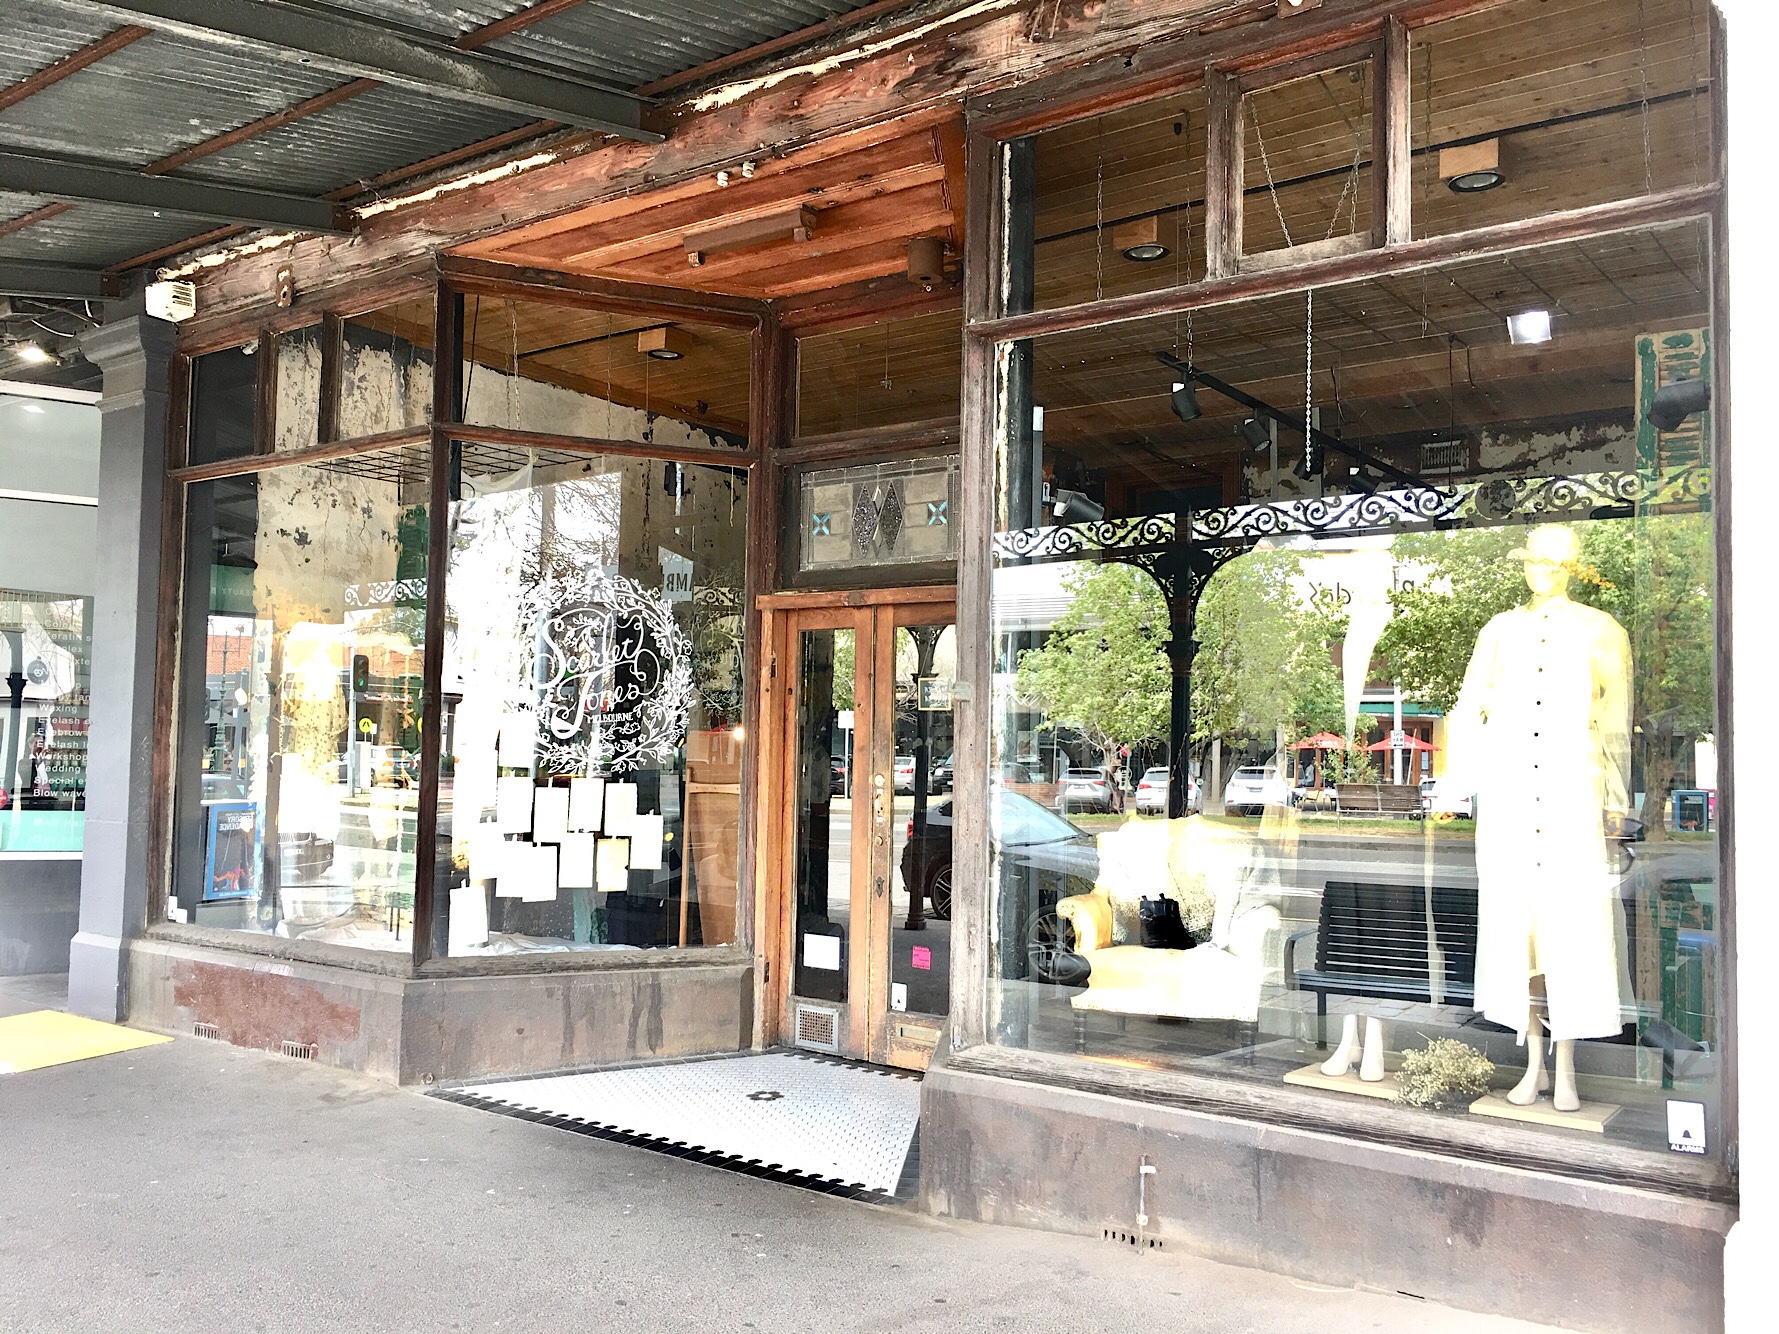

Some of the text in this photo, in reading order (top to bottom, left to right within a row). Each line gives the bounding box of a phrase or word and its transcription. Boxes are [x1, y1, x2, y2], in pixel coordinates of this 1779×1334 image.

[532, 608, 643, 688] Scarlet
[551, 660, 645, 739] Jones
[38, 716, 80, 725] Eelash
[585, 712, 633, 723] MELBOURNE
[38, 727, 83, 737] Eebrow
[37, 739, 79, 749] Eelash
[35, 764, 81, 774] edding
[33, 788, 58, 797] Blow
